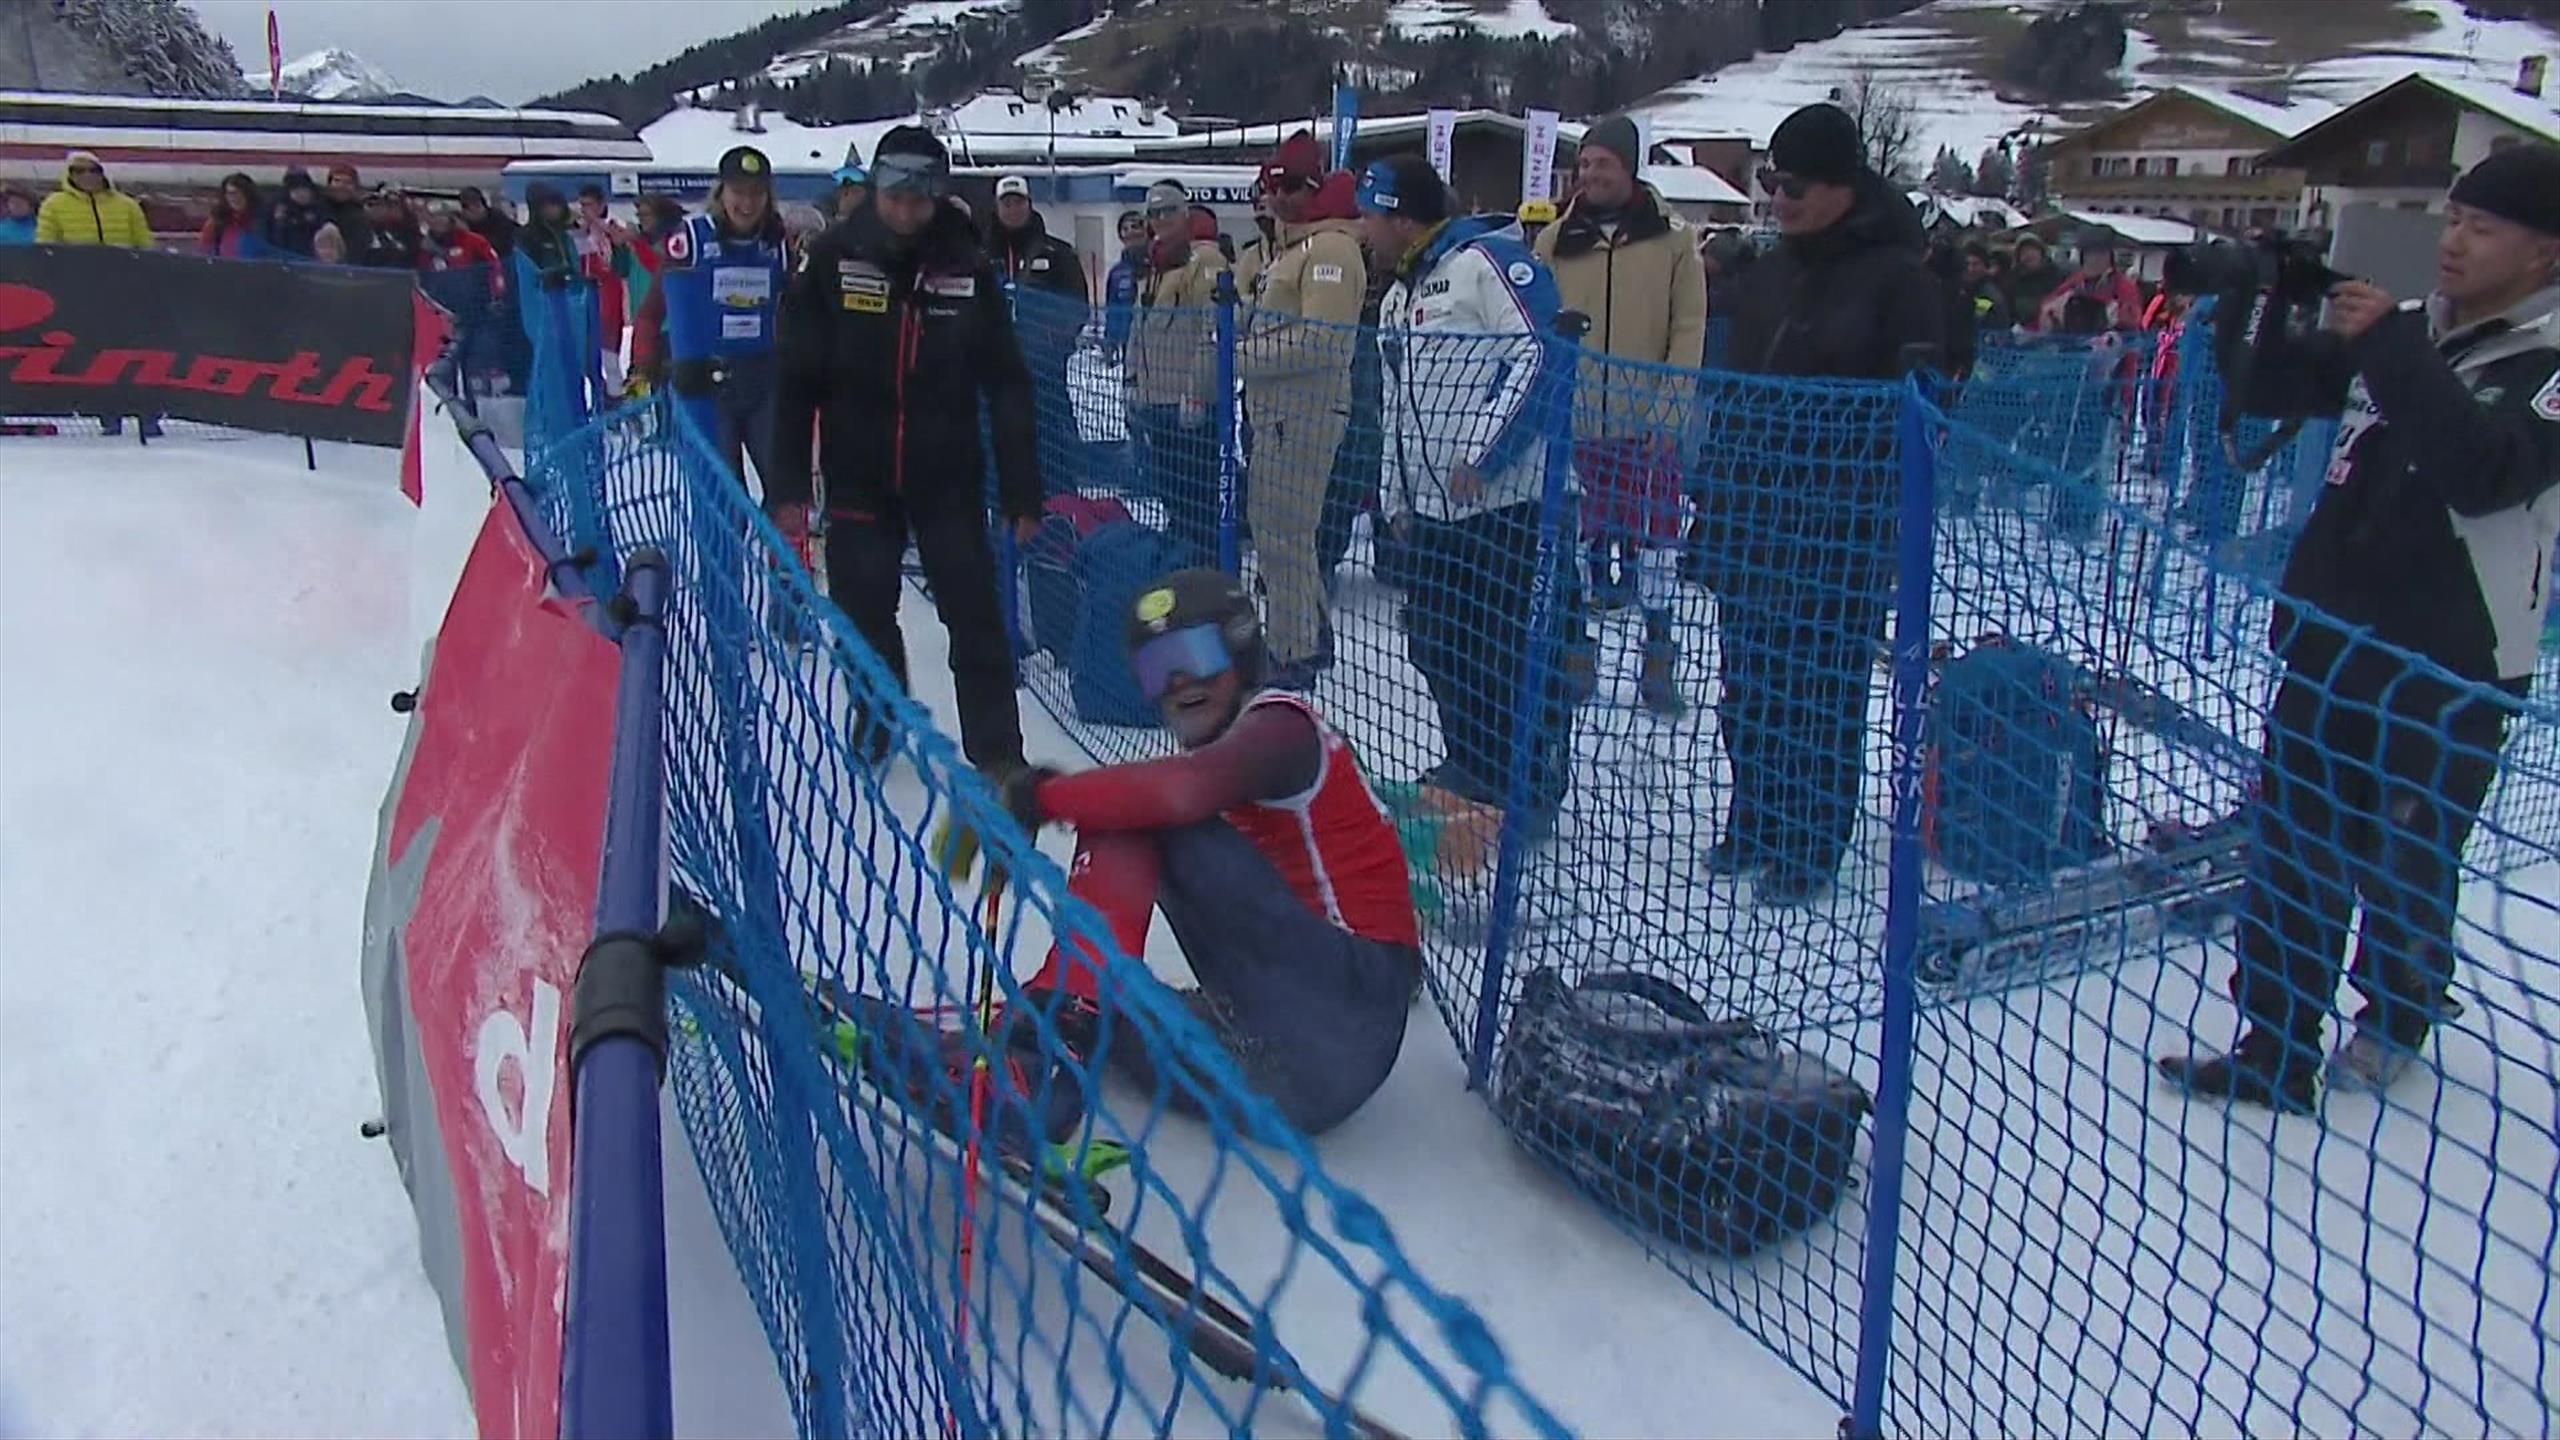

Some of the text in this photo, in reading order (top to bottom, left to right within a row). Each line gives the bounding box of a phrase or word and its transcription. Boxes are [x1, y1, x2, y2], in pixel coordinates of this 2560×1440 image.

[1184, 188, 1212, 201] OTO
[0, 281, 393, 412] inoth
[2242, 293, 2268, 347] SONY
[1907, 681, 1929, 828] LISKI
